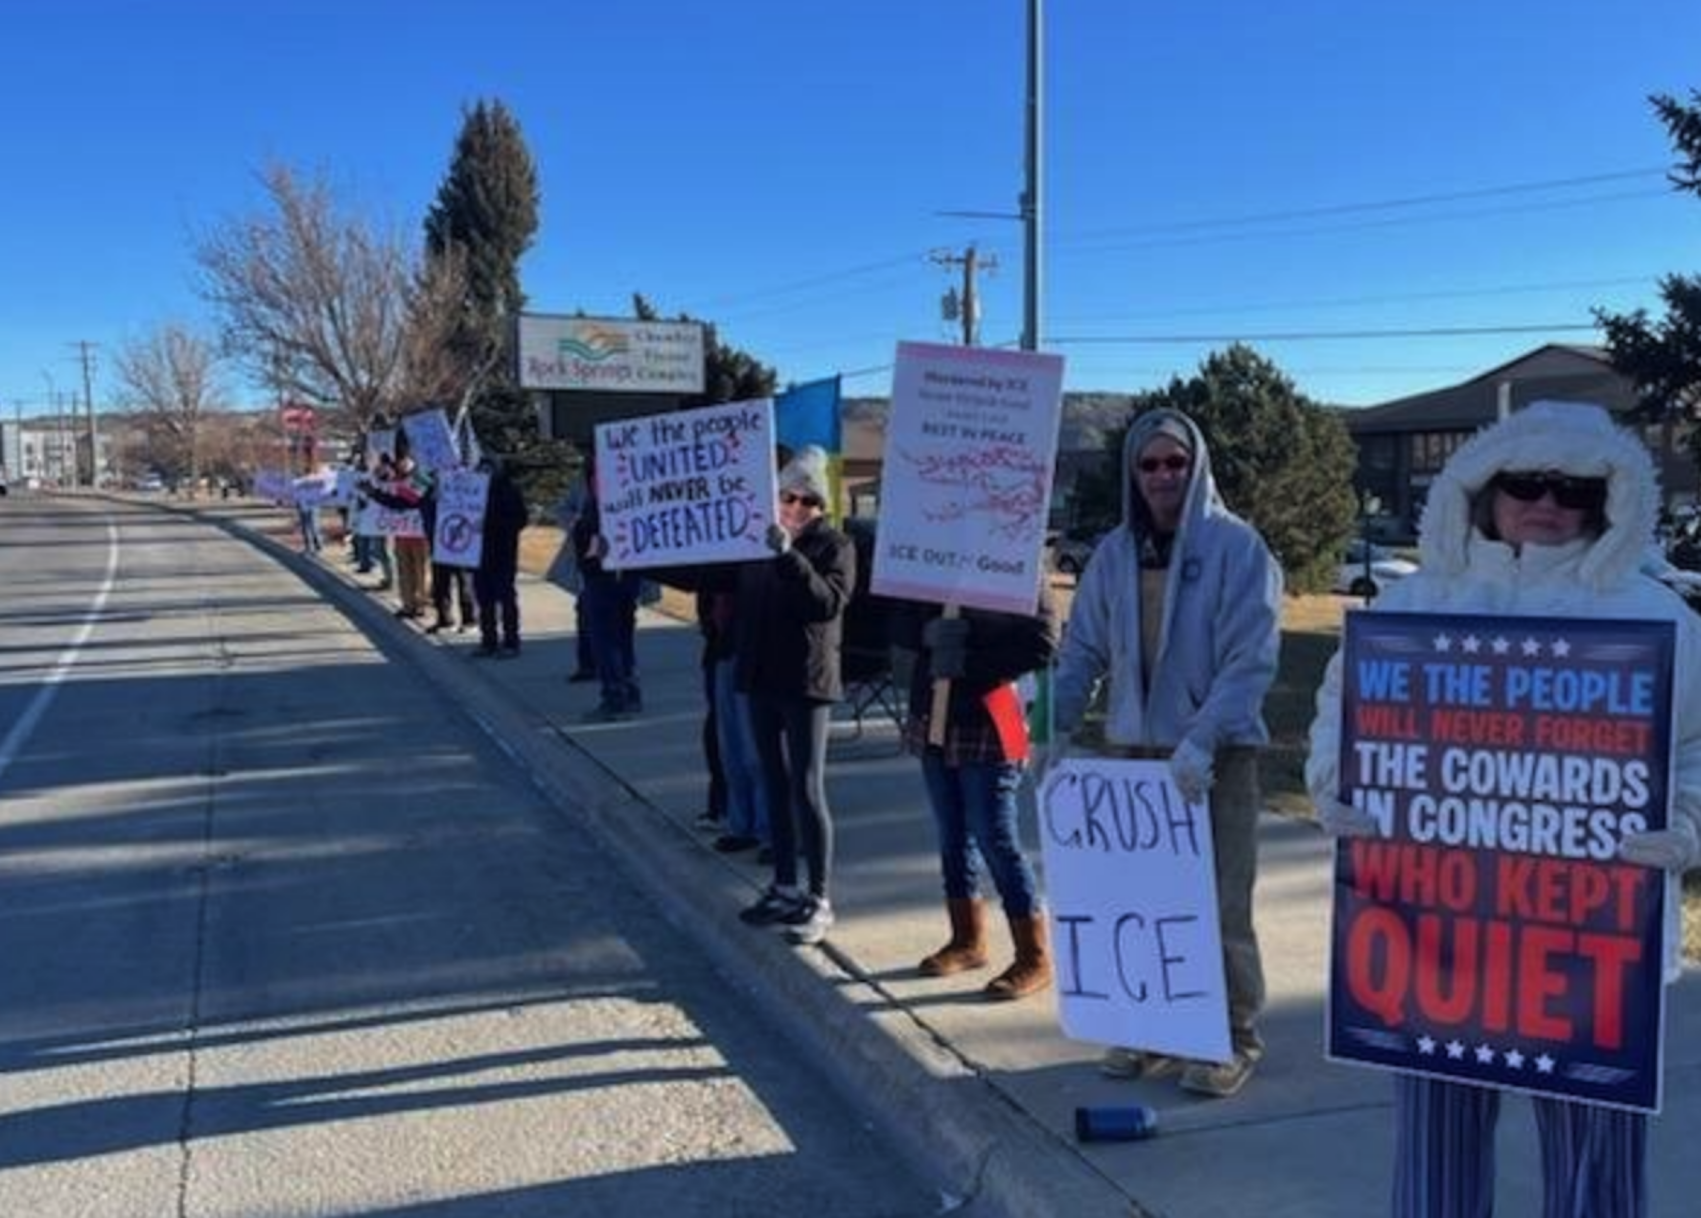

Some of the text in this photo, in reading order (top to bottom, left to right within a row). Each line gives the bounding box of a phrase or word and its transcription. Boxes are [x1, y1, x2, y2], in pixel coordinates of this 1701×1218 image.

[692, 410, 761, 440] people
[980, 429, 1027, 446] PEACE
[650, 476, 710, 503] NEVER
[631, 497, 749, 554] DEFEATED
[888, 545, 919, 561] ICE
[976, 555, 1025, 575] Good
[1358, 660, 1654, 716] WE THE PEOPLE
[1357, 706, 1650, 753] WILL NEVER FORGET
[1354, 741, 1650, 808] THE COWARDS
[1044, 772, 1199, 855] CRUSH
[1354, 840, 1645, 930] WHO KEPT
[1056, 912, 1211, 1004] ICE
[1346, 905, 1641, 1051] QUIET
